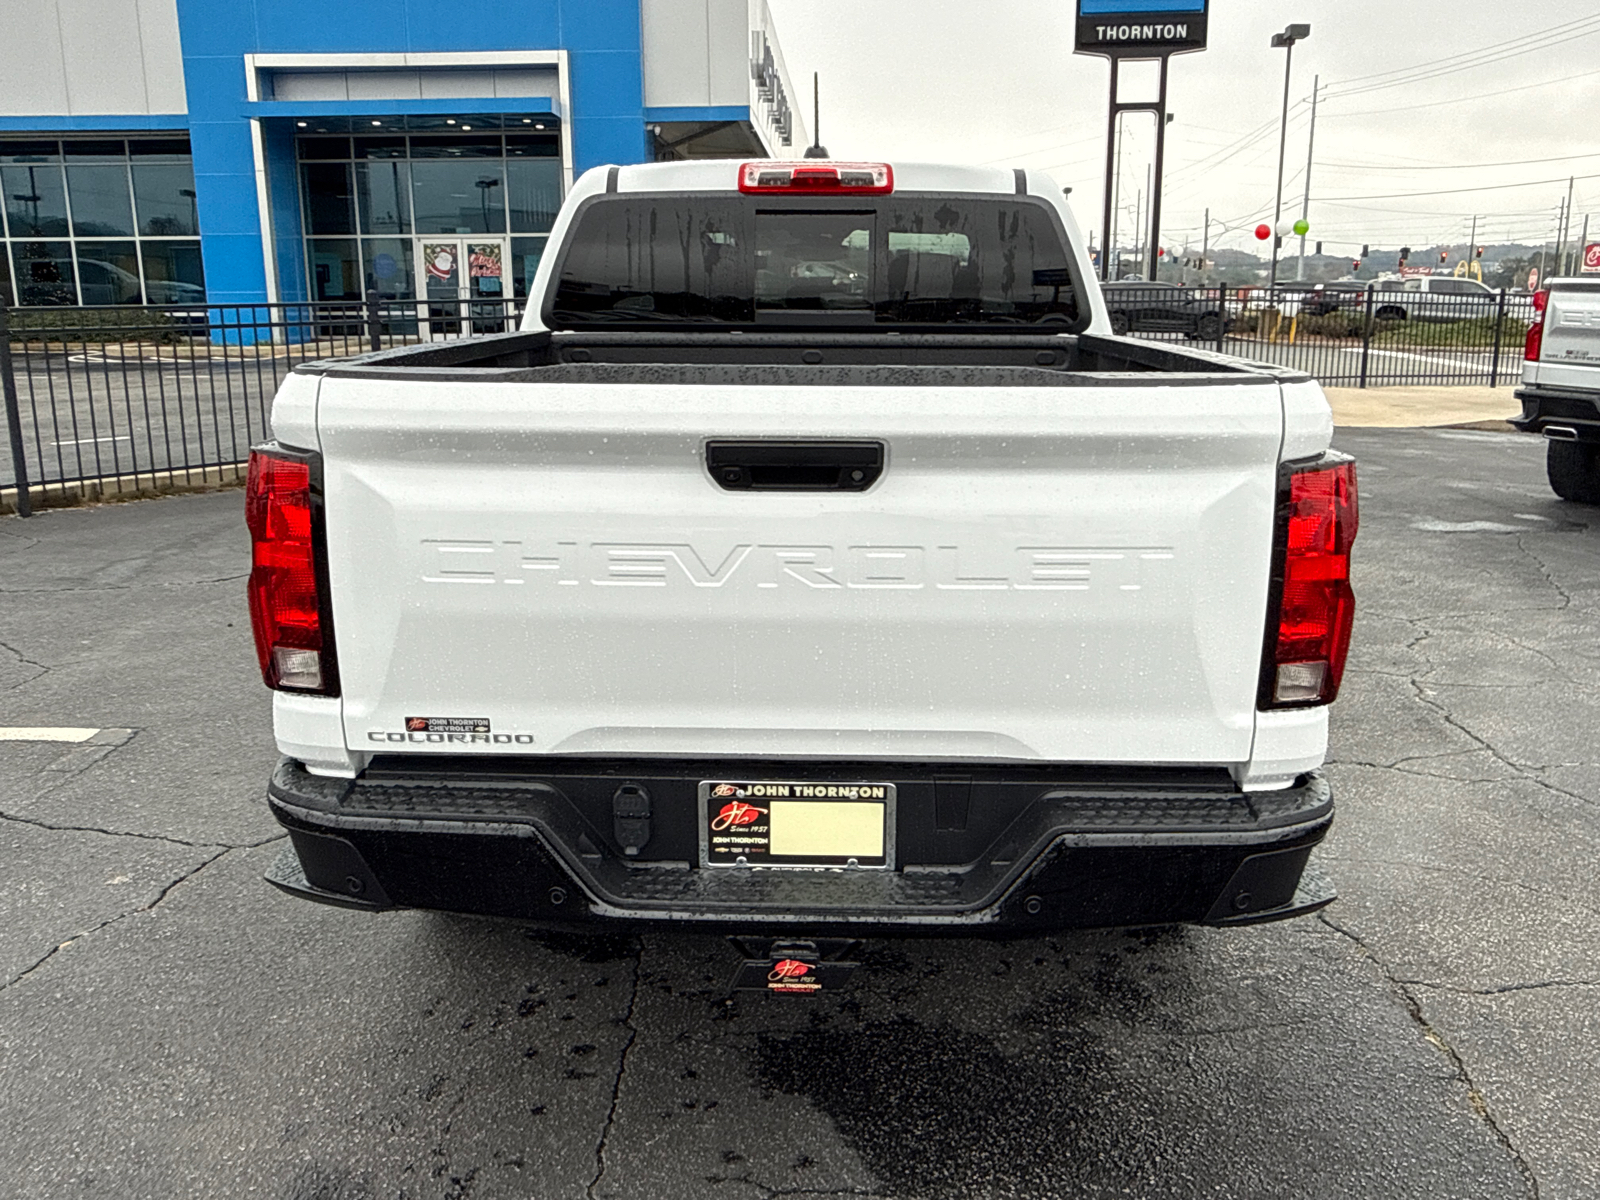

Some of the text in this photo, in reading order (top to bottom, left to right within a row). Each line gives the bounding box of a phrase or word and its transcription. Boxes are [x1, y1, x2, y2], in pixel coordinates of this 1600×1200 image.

[1096, 24, 1188, 41] THORNTON
[420, 539, 1175, 590] CHEVROLET
[428, 718, 489, 727] JOHN THORNTON
[367, 731, 534, 744] COLORADO
[745, 785, 885, 798] JOHN THORNTON
